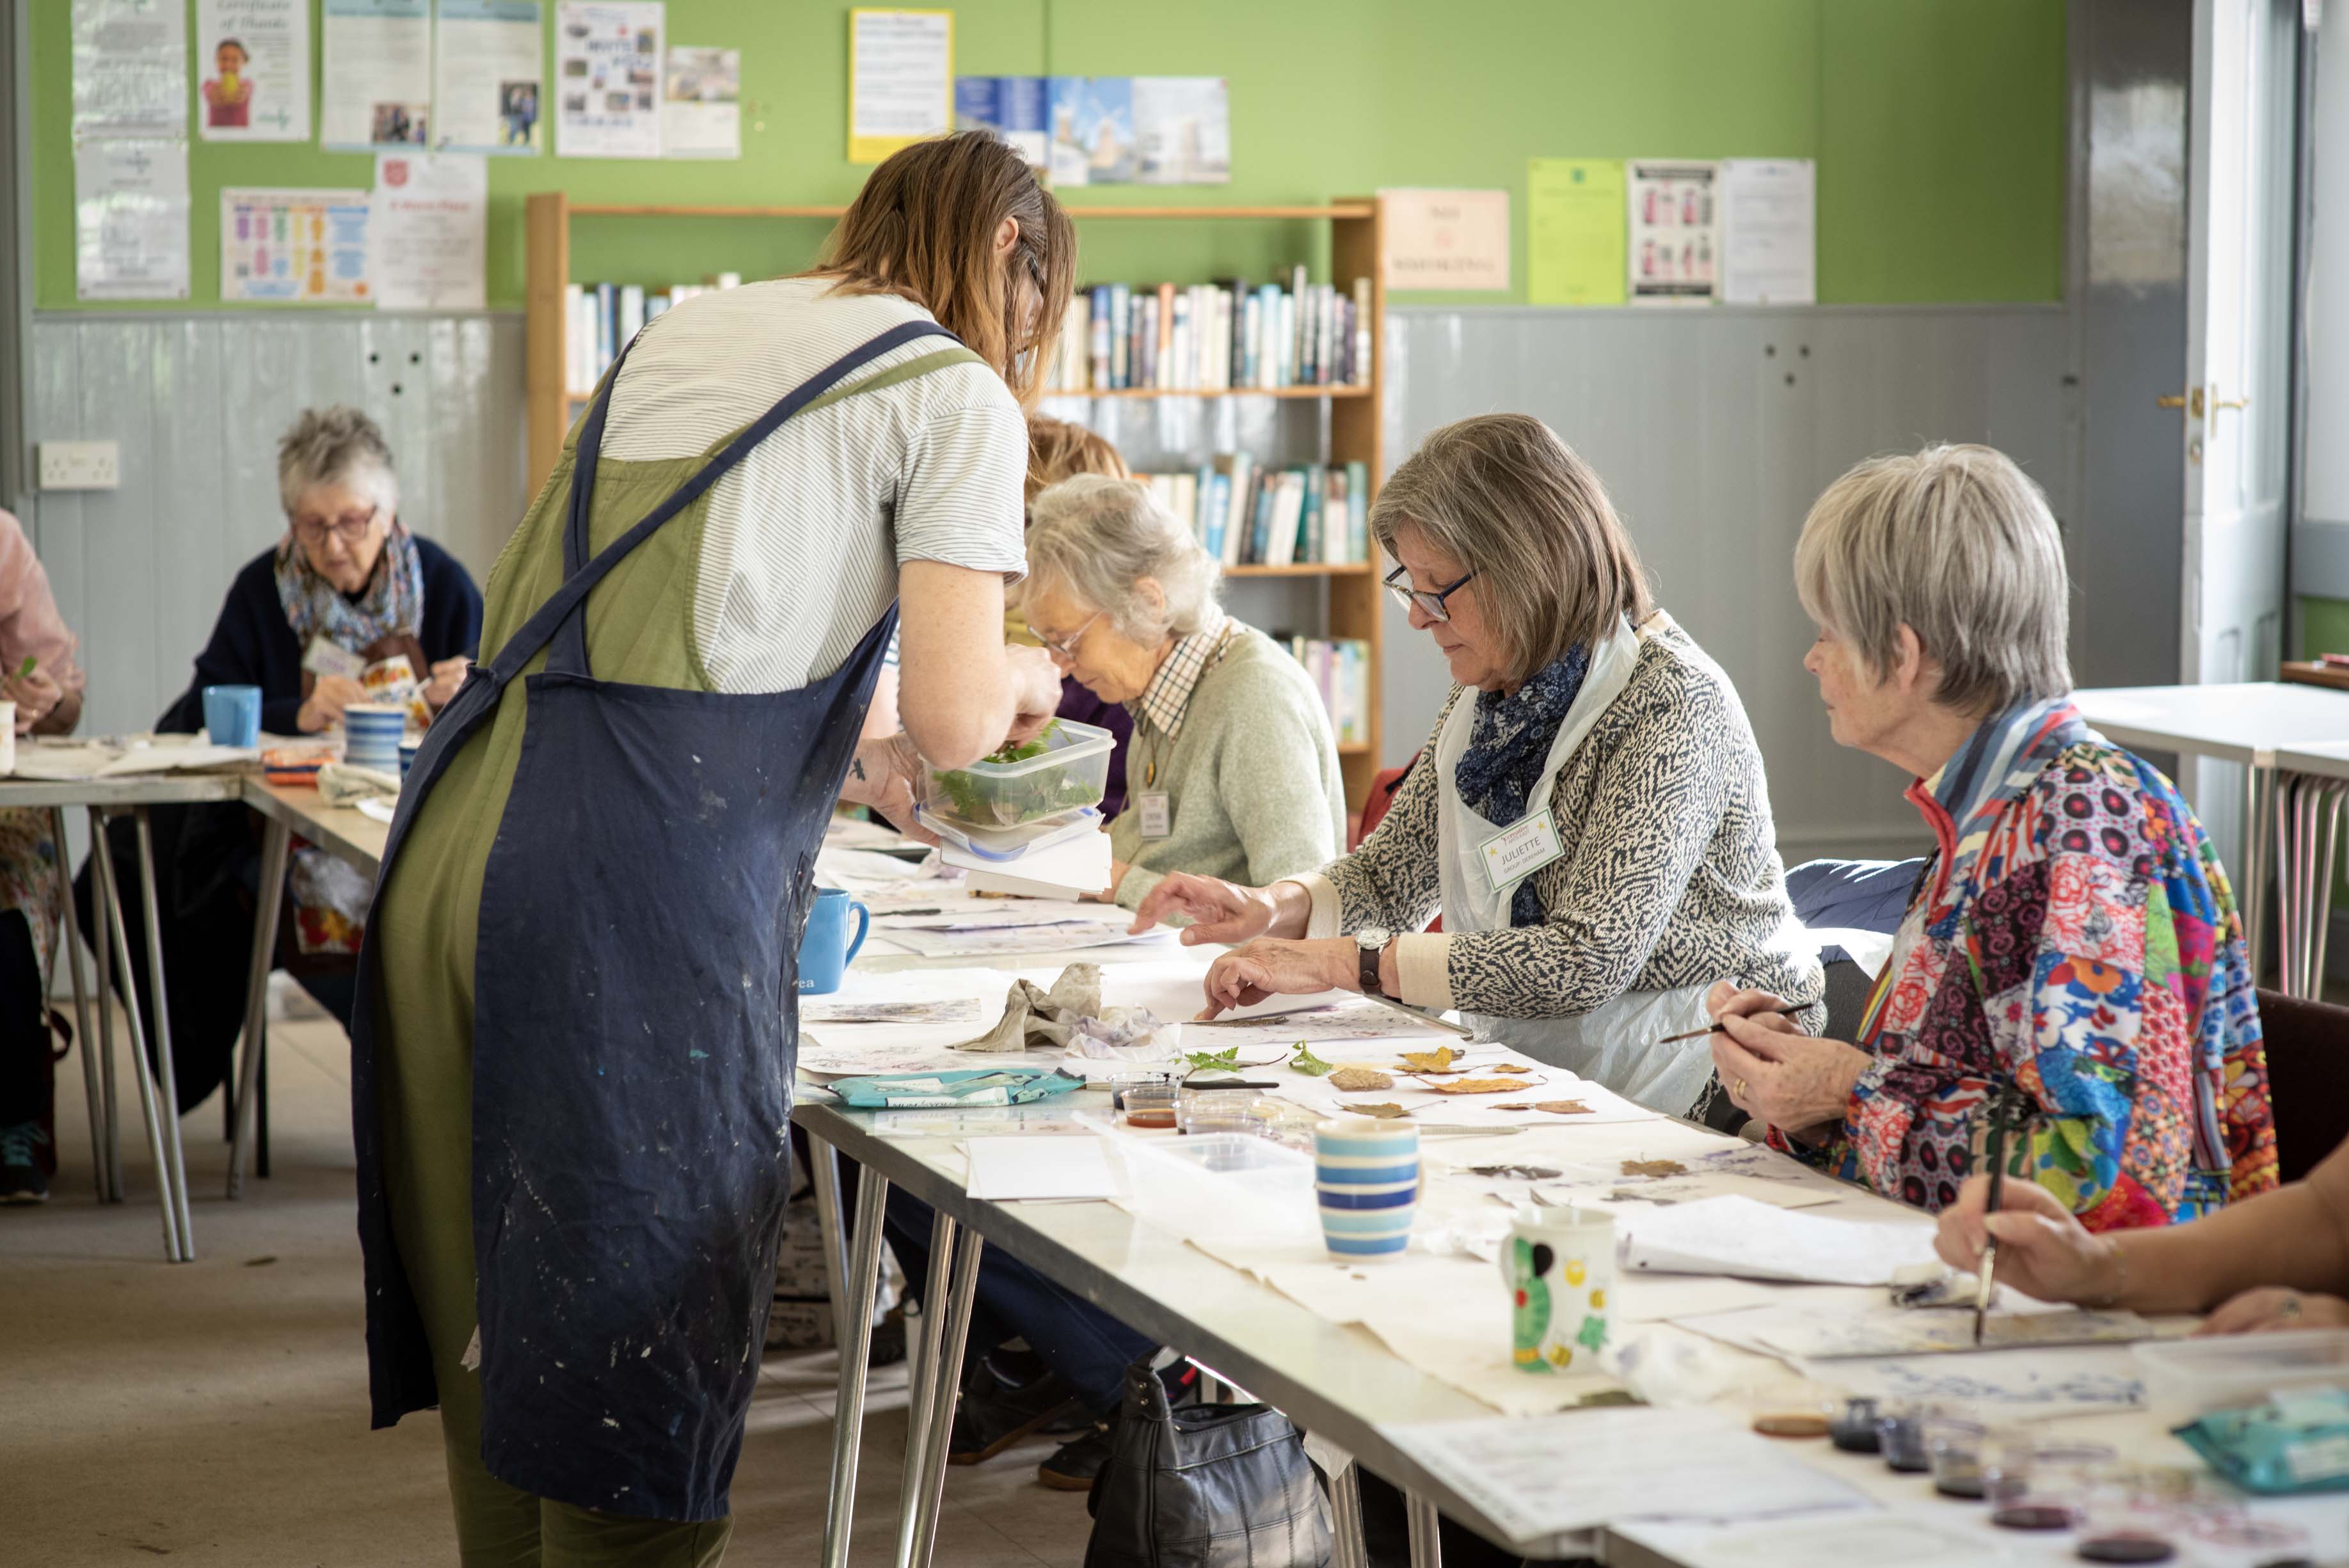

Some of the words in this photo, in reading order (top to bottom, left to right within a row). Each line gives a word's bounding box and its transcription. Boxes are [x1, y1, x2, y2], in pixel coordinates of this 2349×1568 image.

[1502, 835, 1541, 865] JULIETTE
[1522, 848, 1546, 864] DEREHAM
[799, 979, 815, 988] ea
